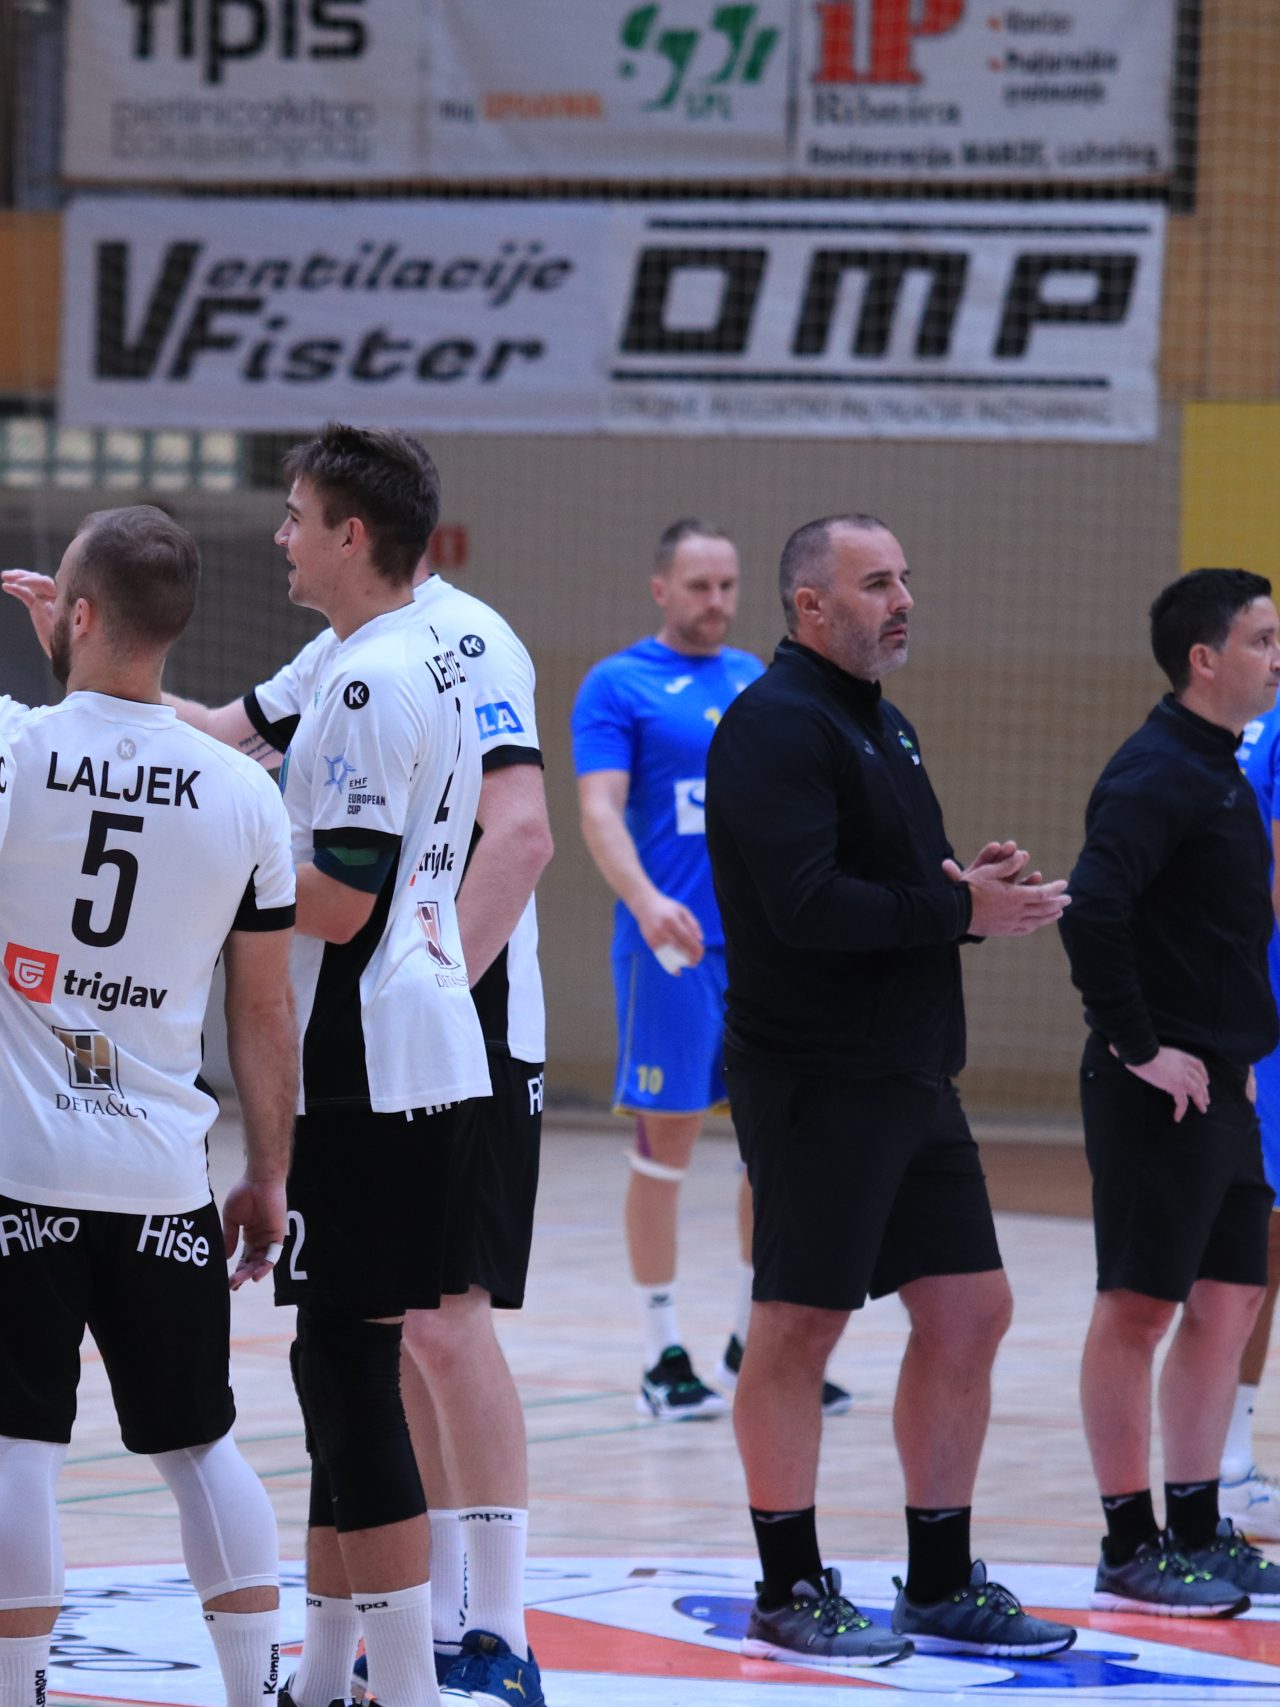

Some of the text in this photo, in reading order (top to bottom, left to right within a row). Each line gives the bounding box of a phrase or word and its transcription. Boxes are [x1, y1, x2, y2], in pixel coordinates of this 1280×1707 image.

[167, 296, 545, 382] Fister
[46, 751, 201, 809] LALJEK
[348, 793, 386, 806] EUROPEAN
[349, 777, 368, 788] EHF
[347, 804, 361, 815] CUP
[71, 810, 144, 948] 5
[63, 969, 168, 1012] triglav
[637, 1065, 664, 1095] 10
[136, 1214, 210, 1267] Hiše
[286, 1210, 308, 1280] 2
[263, 1643, 280, 1695] Kempa
